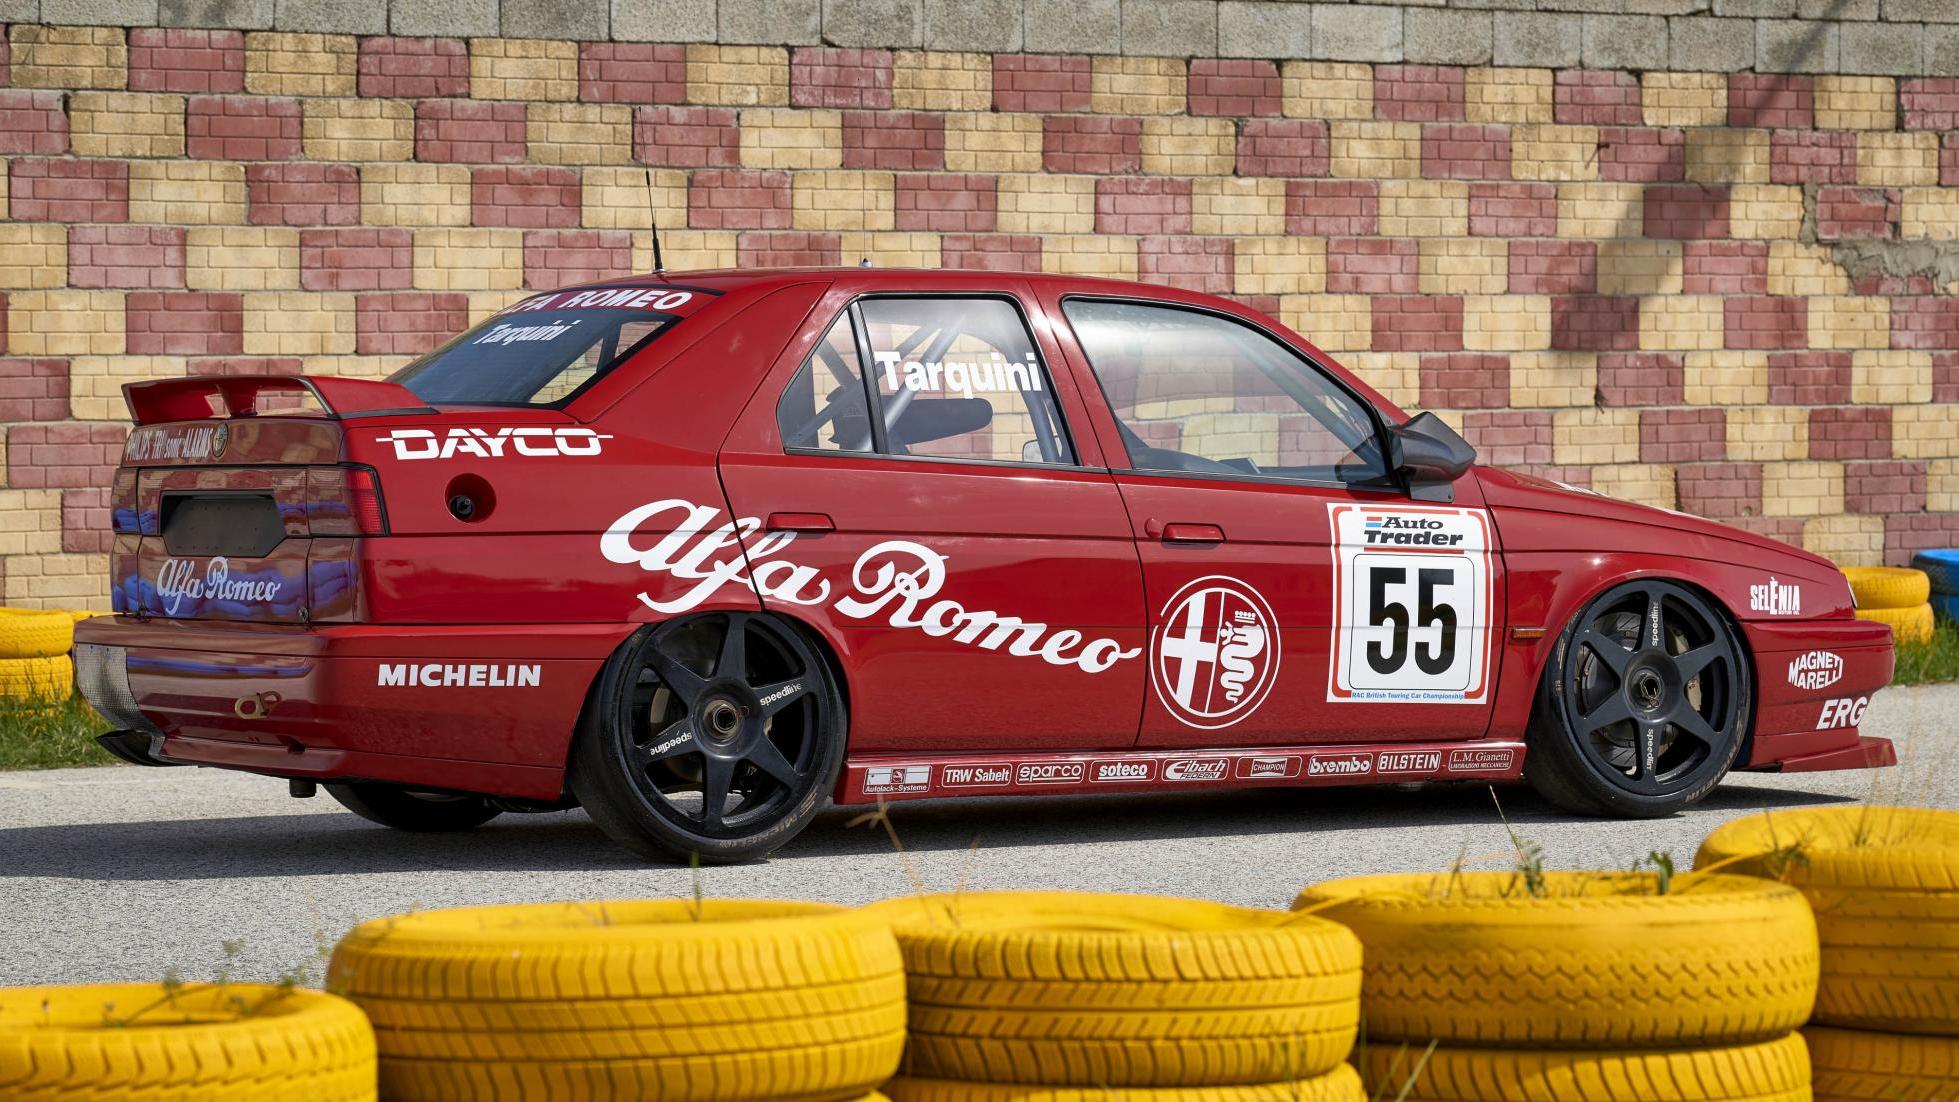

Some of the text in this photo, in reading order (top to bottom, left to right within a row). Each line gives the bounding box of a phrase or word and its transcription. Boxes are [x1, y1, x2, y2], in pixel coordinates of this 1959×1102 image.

[557, 288, 693, 310] ROMEO
[472, 319, 582, 346] Tarquini
[873, 351, 1042, 399] Tarquini
[390, 427, 602, 461] DAYCO
[1382, 516, 1443, 529] Auto
[1364, 530, 1463, 546] Trader
[157, 556, 281, 616] Alfa Romeo
[600, 498, 1142, 673] Alfa Romeo
[1367, 567, 1457, 675] 55
[378, 663, 541, 687] MICHELIN
[1788, 666, 1844, 690] MARELLI
[1388, 692, 1410, 700] Touring
[1815, 696, 1868, 730] ERG
[650, 732, 692, 755] speedline
[1646, 728, 1654, 770] speedlin
[1253, 763, 1285, 771] CHAMPION
[1309, 754, 1371, 774] brembo
[1379, 752, 1440, 771] BILSTEIN
[1475, 751, 1510, 762] Gianetti
[945, 766, 1009, 783] TRW Sabelt
[1019, 763, 1081, 779] sparco
[1099, 762, 1148, 776] soteco
[1166, 759, 1226, 778] Eibach
